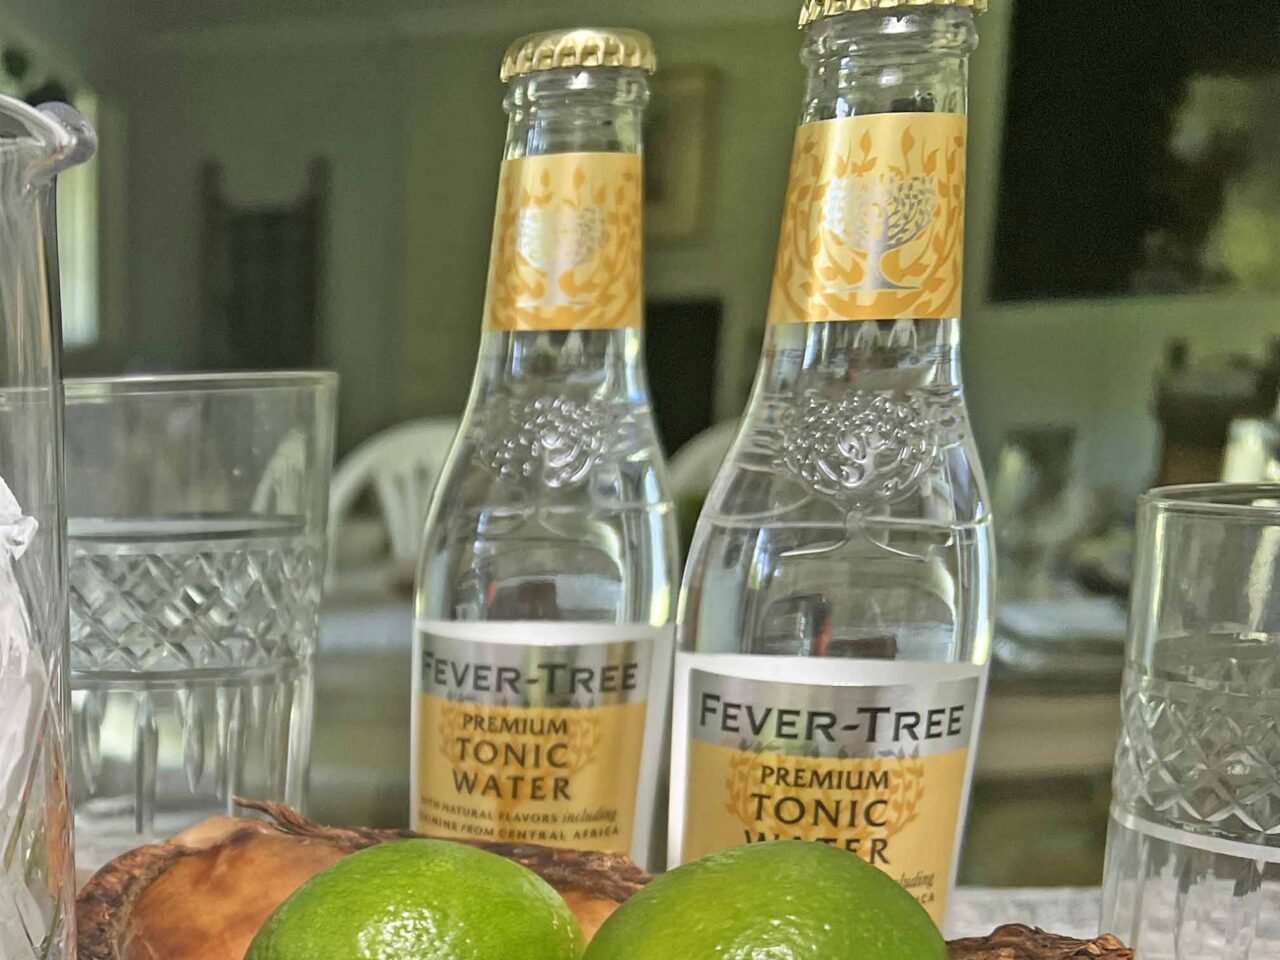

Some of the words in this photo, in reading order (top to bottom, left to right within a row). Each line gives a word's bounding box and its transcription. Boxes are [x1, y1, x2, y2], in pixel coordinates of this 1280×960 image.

[421, 652, 639, 695] FEVER-TREE
[462, 712, 569, 736] PREMIUM
[698, 692, 965, 743] FEVER-TREE
[456, 737, 569, 770] TONIC
[452, 769, 572, 801] WATER
[760, 764, 890, 792] PREMIUM
[442, 803, 493, 821] NATURAL
[498, 812, 558, 824] FLAVORS
[561, 806, 618, 824] including
[750, 792, 889, 828] TONIC
[460, 823, 495, 837] FROM
[498, 827, 565, 842] CENTRAL
[572, 825, 619, 841] AFRICA
